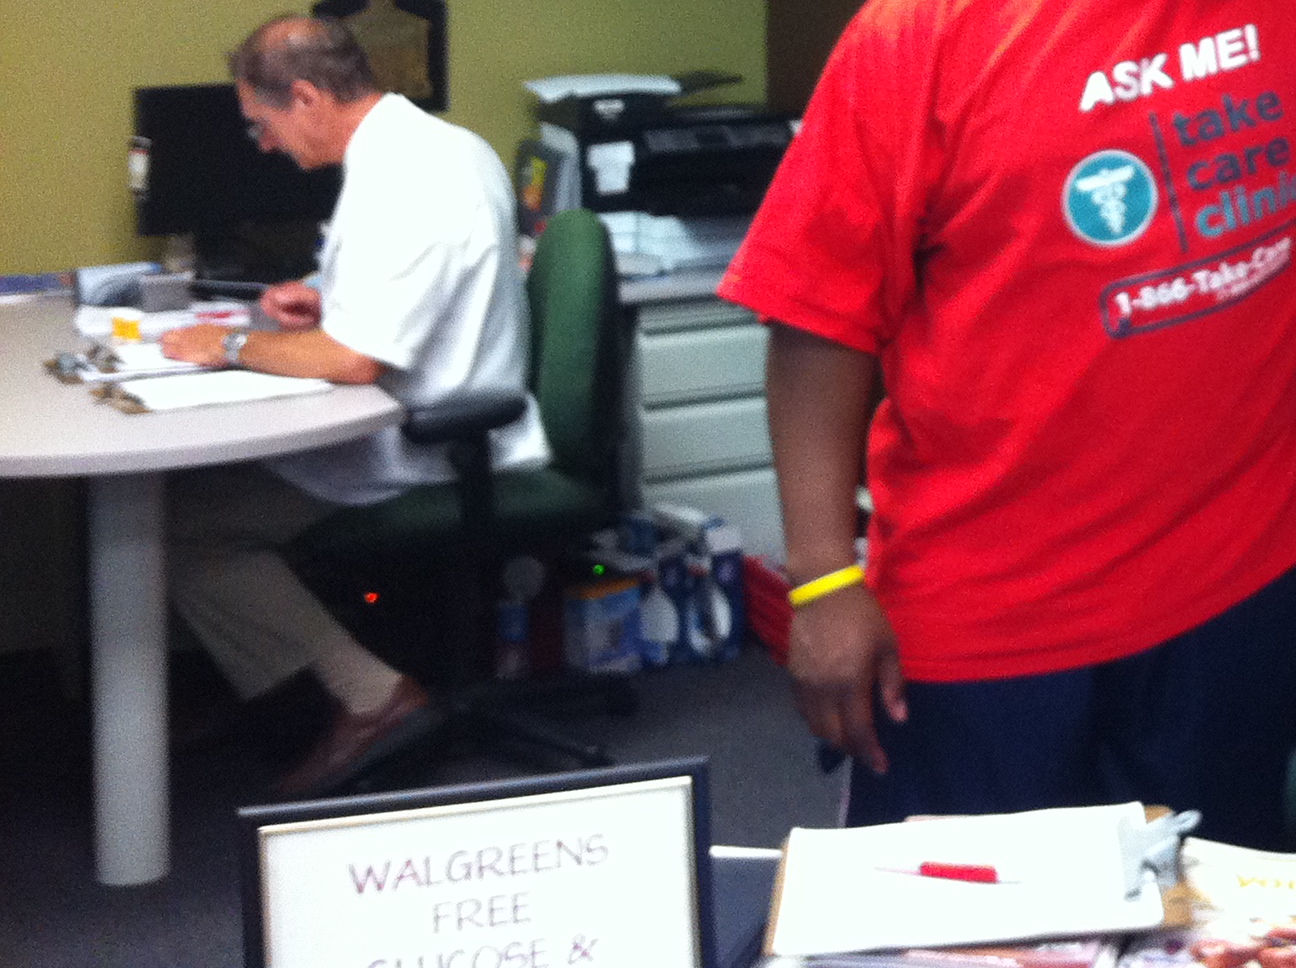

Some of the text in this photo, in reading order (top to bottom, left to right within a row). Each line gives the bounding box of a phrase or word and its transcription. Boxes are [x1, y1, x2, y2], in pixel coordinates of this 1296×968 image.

[1078, 22, 1262, 113] ASK ME!
[1171, 90, 1285, 147] take
[1186, 135, 1291, 191] care
[347, 832, 610, 895] WALGREENS
[432, 891, 532, 934] FREE
